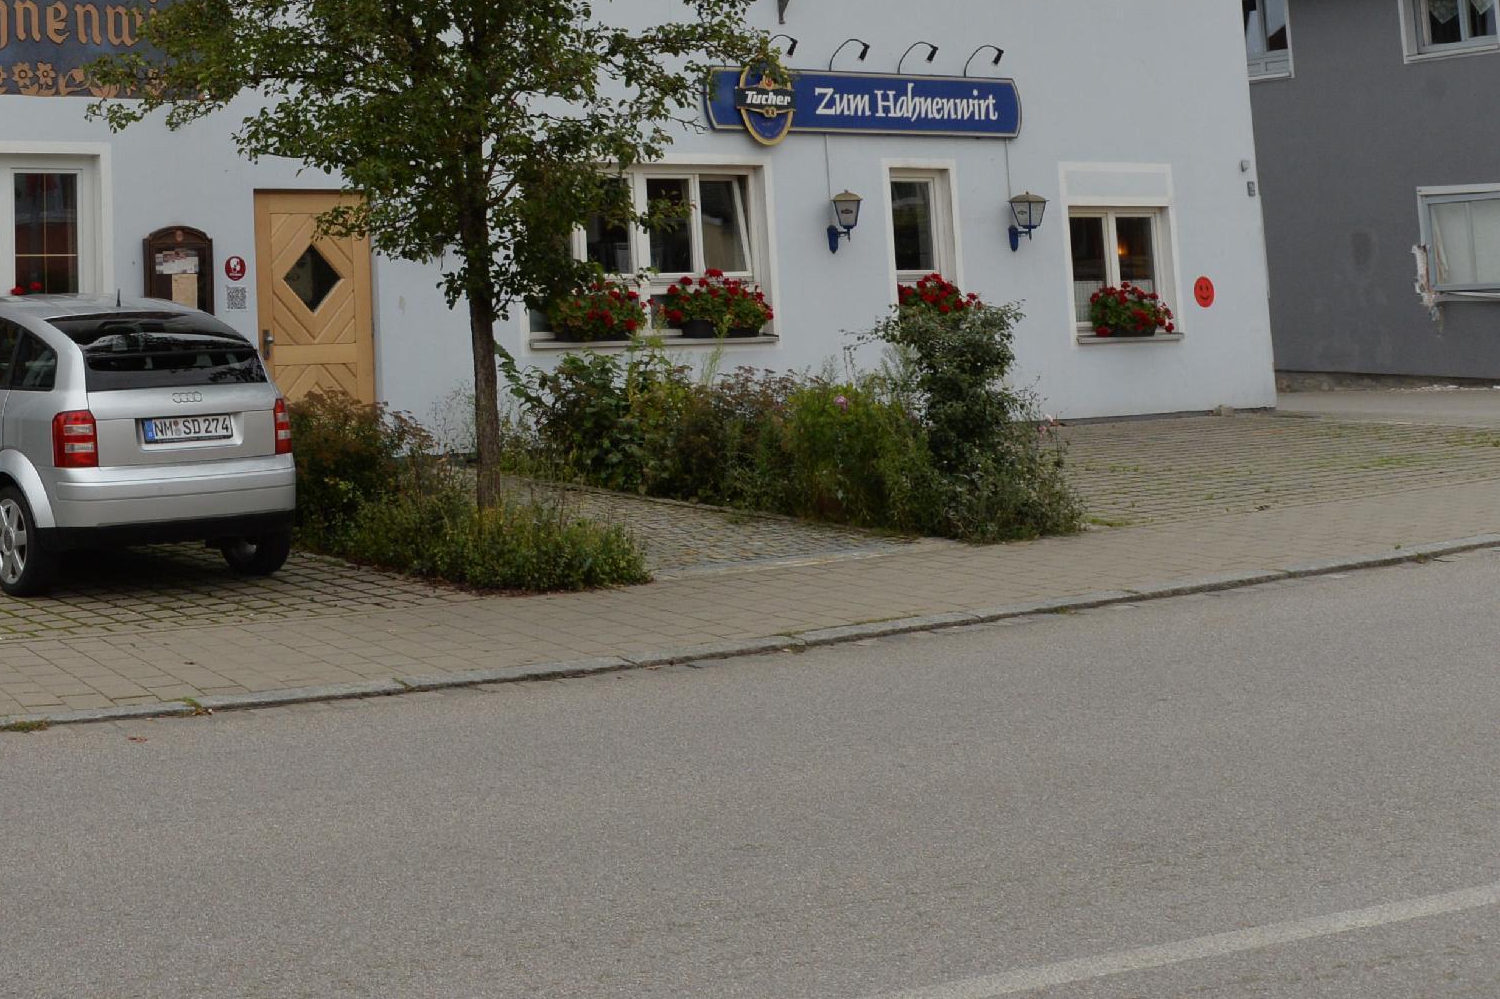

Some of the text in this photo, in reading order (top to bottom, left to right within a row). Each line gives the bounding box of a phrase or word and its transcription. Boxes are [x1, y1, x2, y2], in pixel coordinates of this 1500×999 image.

[744, 90, 792, 106] Tucher
[814, 82, 998, 122] Zum Hahnenwirt
[154, 417, 230, 436] NM SD 274
